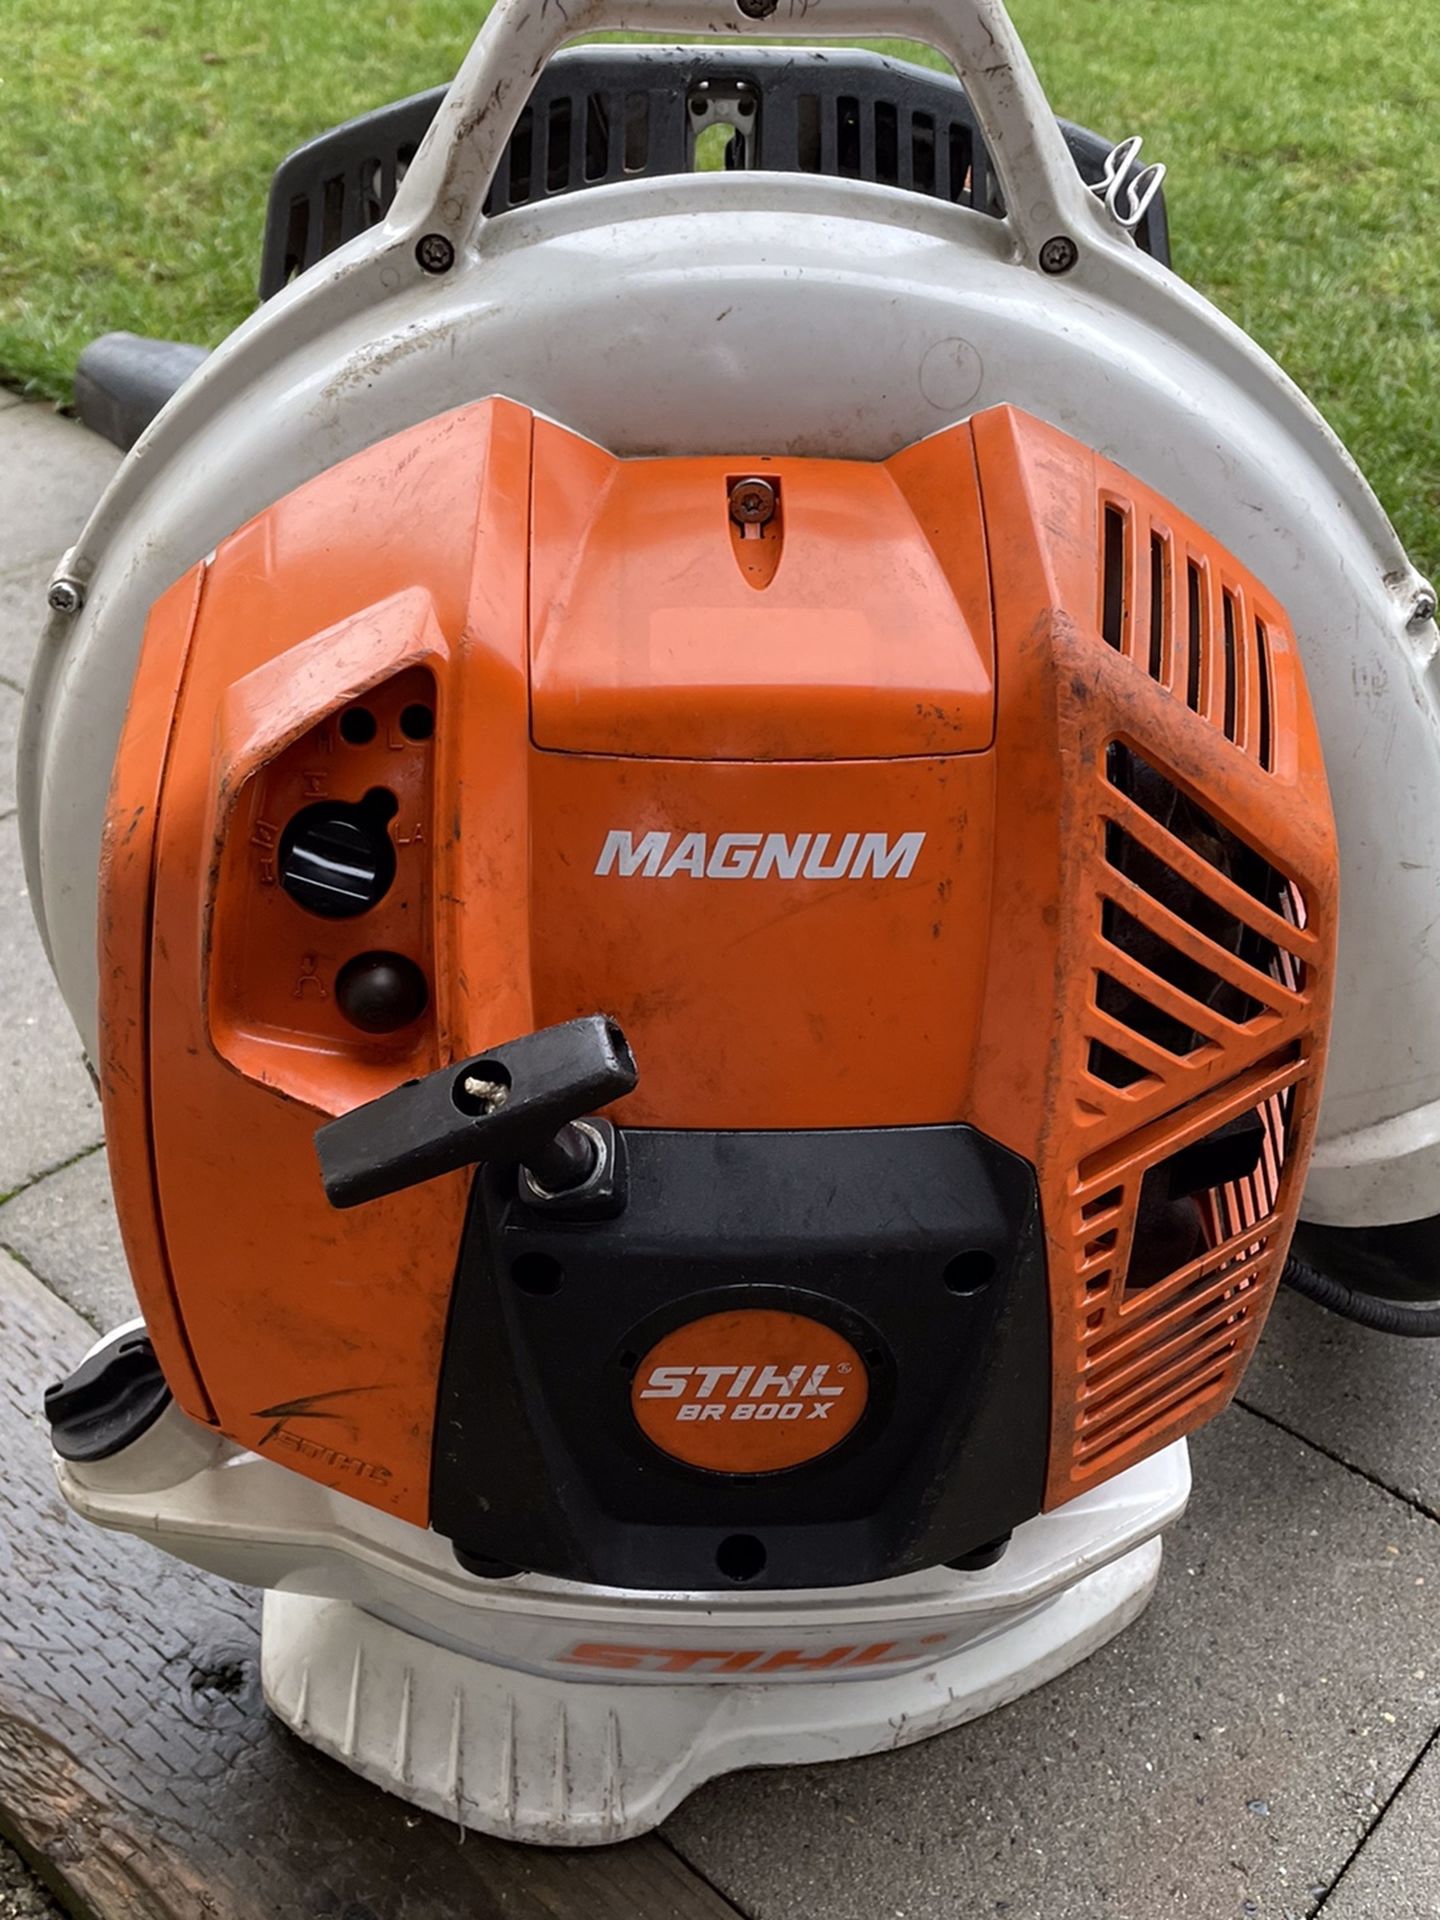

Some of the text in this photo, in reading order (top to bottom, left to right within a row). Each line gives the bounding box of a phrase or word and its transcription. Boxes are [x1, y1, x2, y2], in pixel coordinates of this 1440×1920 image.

[594, 830, 927, 880] MAGNUM
[640, 1364, 845, 1399] STIHL
[676, 1402, 835, 1421] BR 800 X
[552, 1641, 918, 1674] STIHL
